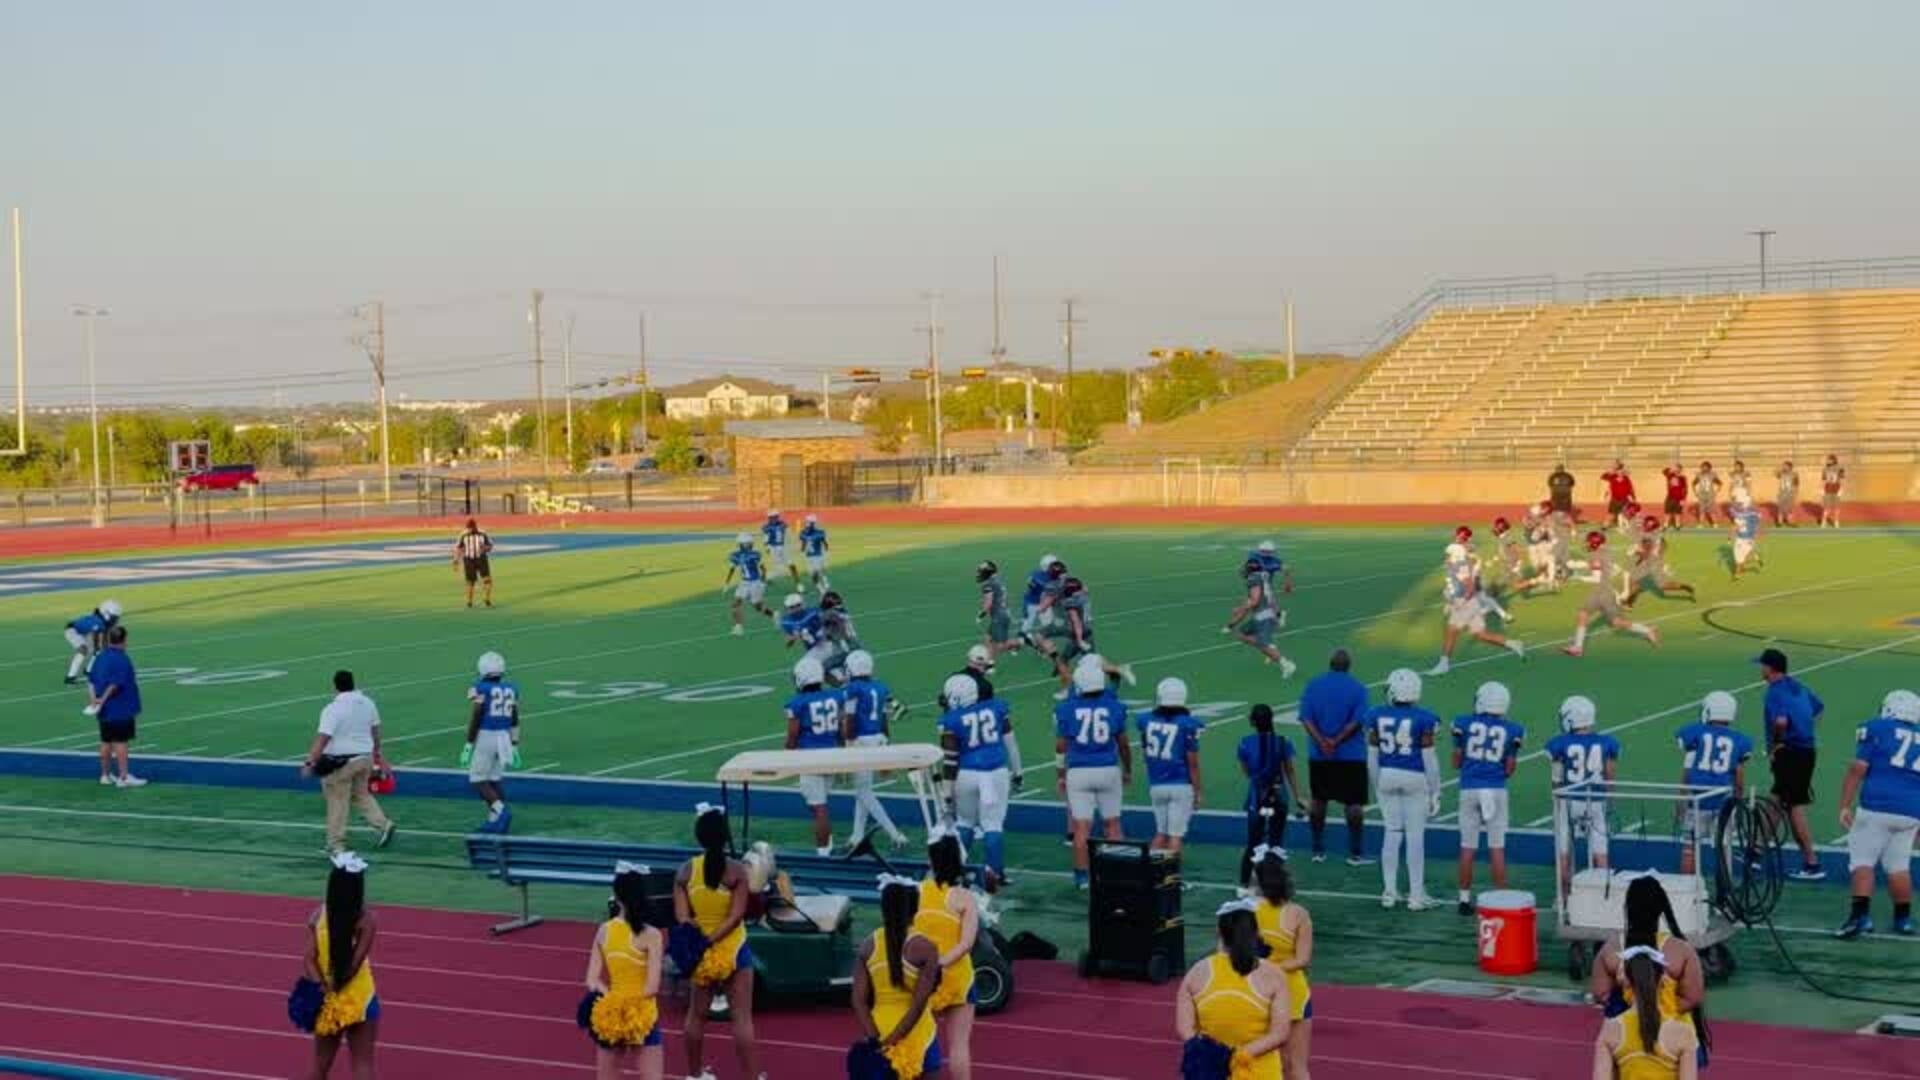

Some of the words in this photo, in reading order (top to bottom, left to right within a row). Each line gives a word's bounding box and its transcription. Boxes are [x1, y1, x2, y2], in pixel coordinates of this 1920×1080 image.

[490, 687, 515, 717] 22
[810, 699, 839, 735] 52
[870, 688, 879, 721] 1
[962, 708, 998, 748] 72
[1075, 707, 1110, 744] 76
[1146, 722, 1179, 760] 57
[1377, 717, 1413, 755] 54
[1467, 721, 1507, 762] 23
[1567, 743, 1604, 783] 34
[1699, 733, 1734, 773] 13
